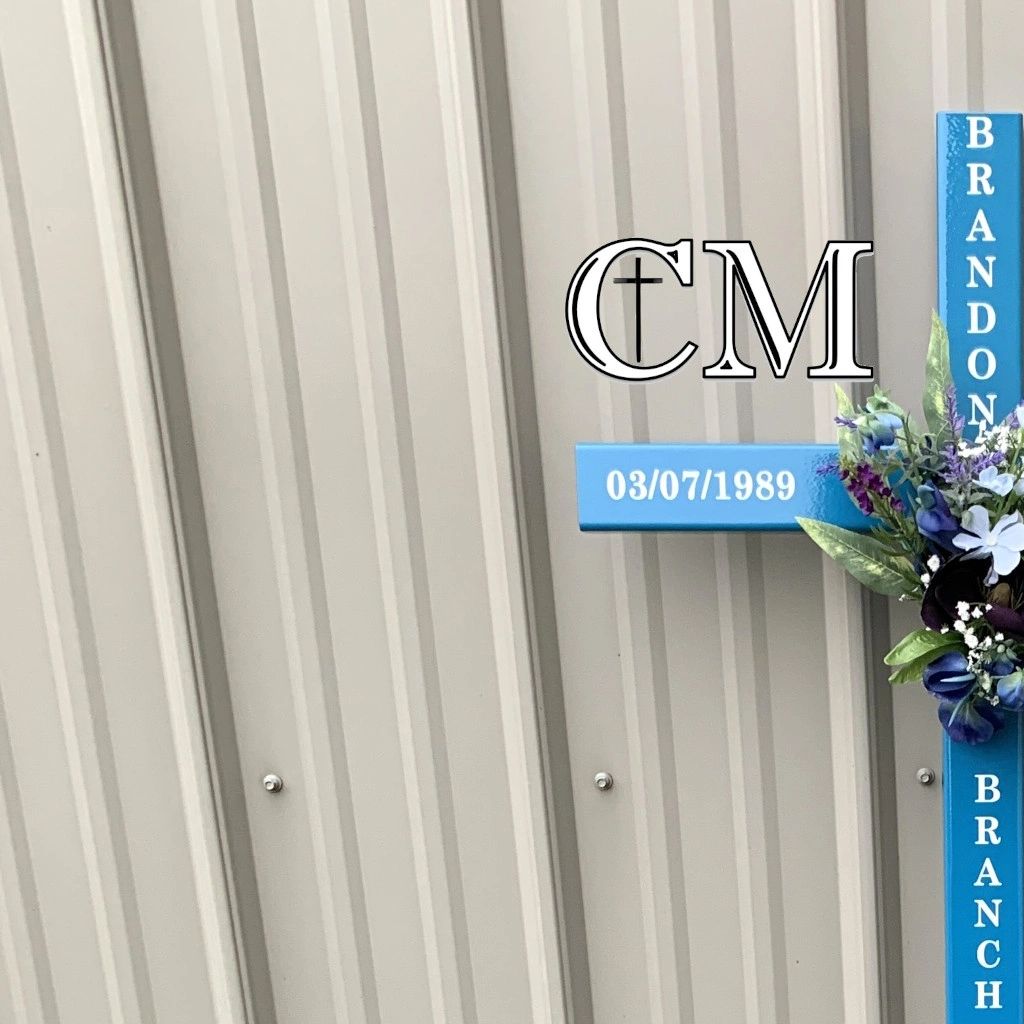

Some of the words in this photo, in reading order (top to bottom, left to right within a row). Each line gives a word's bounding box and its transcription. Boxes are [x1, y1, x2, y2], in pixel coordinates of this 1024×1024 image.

[965, 116, 997, 426] BRANDON
[606, 469, 796, 501] 03/07/1989
[974, 773, 1003, 1009] BRANCH
